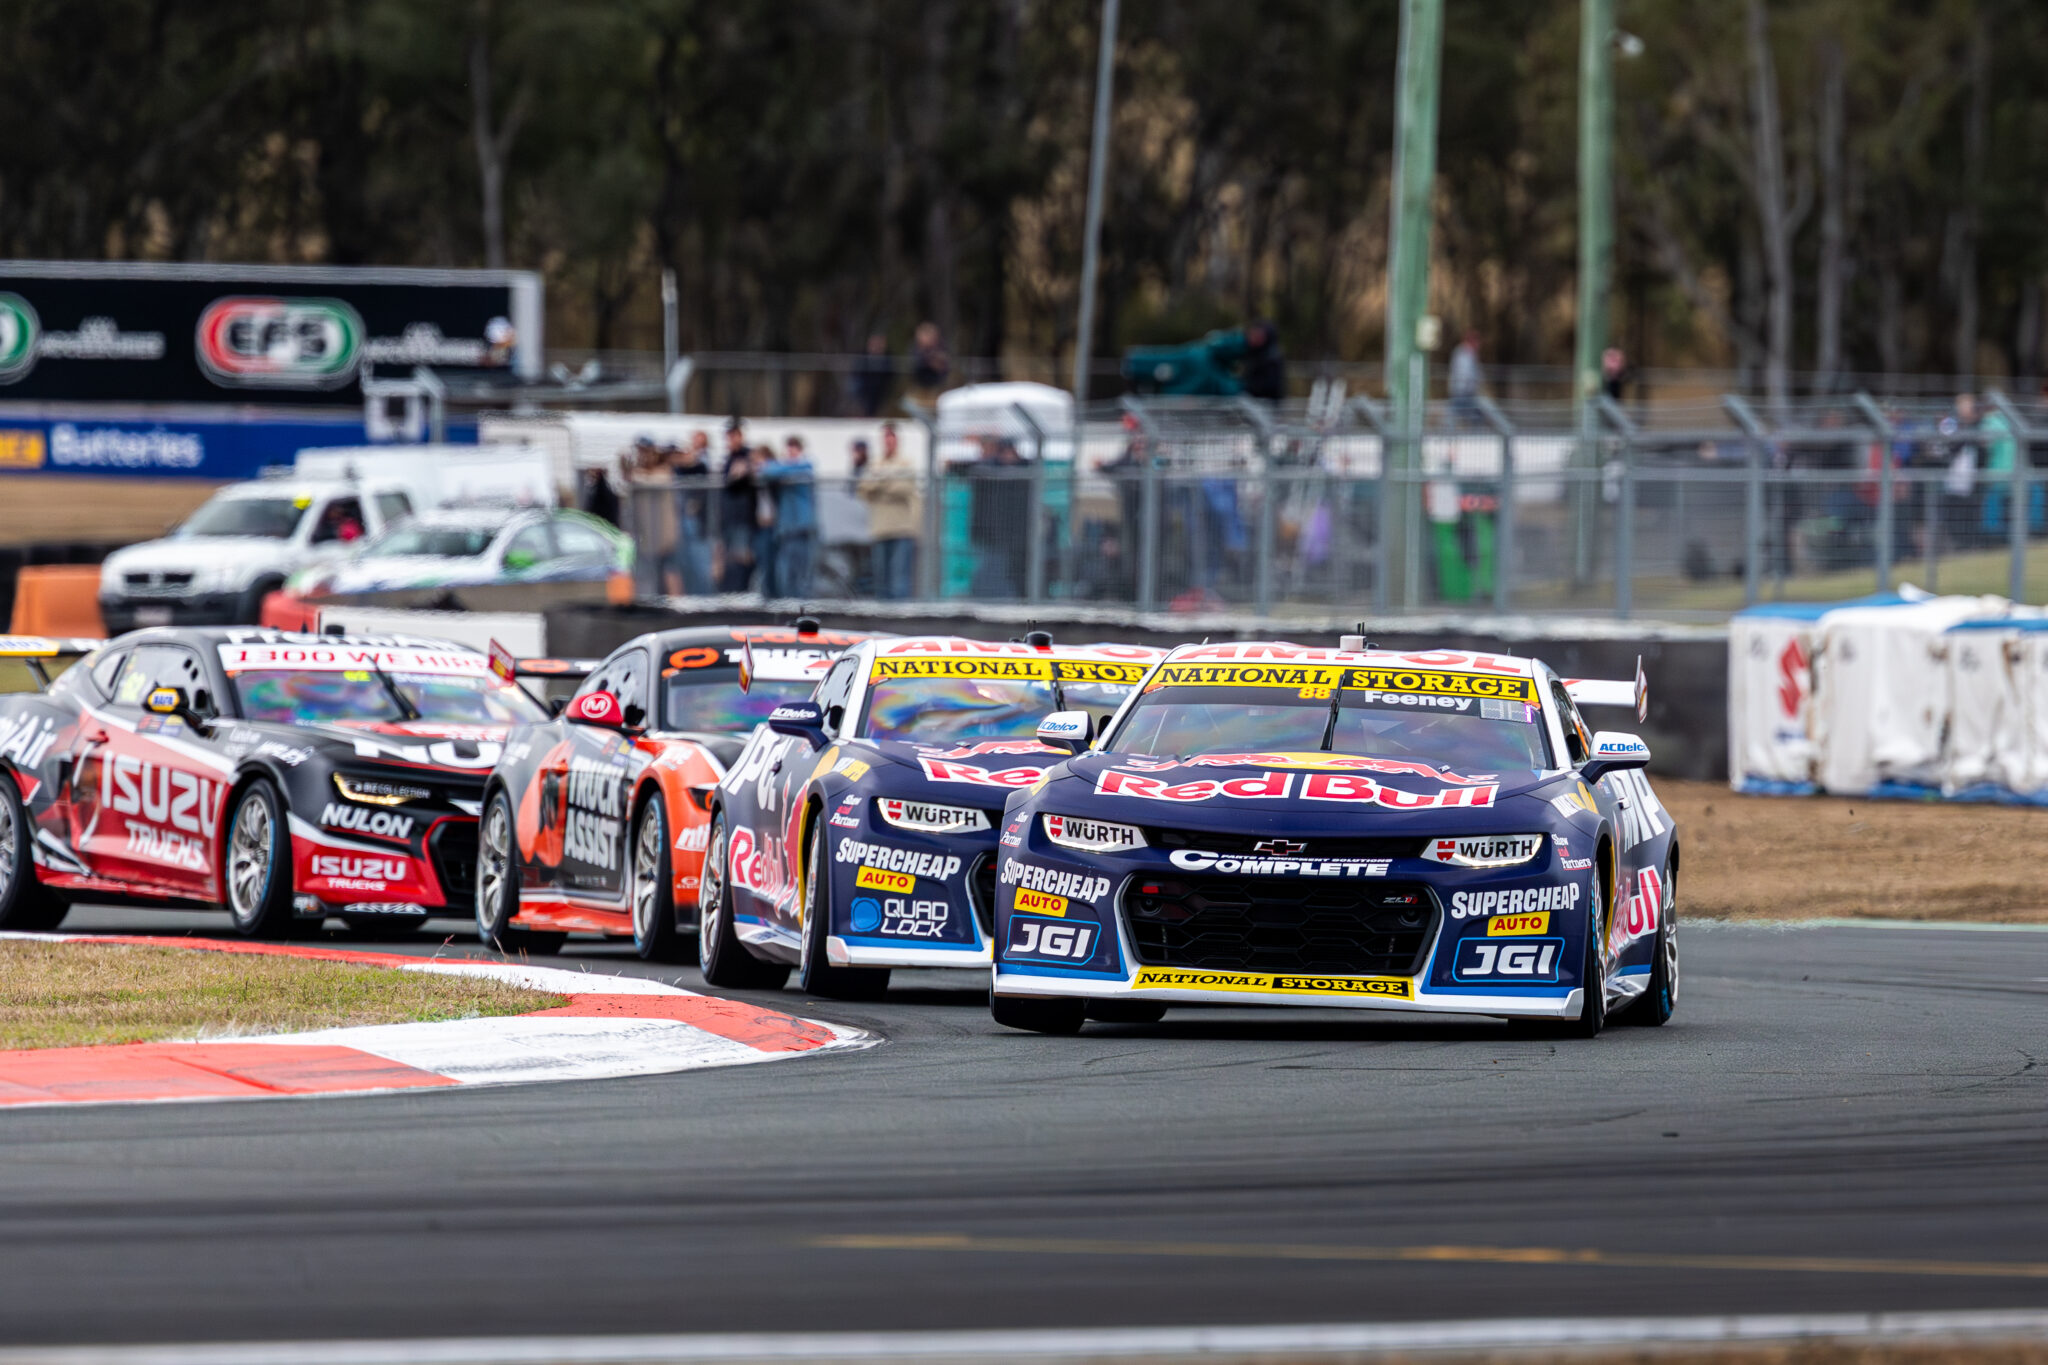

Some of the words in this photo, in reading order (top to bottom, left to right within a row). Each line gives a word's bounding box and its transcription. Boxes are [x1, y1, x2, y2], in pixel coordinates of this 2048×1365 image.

[52, 423, 205, 468] Batteries
[235, 650, 336, 664] 1300
[879, 660, 1042, 676] NATIONAL
[1058, 663, 1146, 681] STOR
[1159, 668, 1332, 685] NATIONAL
[1353, 671, 1521, 697] STORAGE
[1298, 687, 1331, 699] 88
[1365, 690, 1472, 710] Feeney
[103, 750, 224, 839] ISUZU
[567, 754, 625, 818] TRUCK
[1094, 770, 1295, 802] Red
[1300, 773, 1499, 809] Bull
[320, 802, 414, 839] NULON
[906, 805, 977, 827] WÜRTH
[125, 818, 204, 870] TRUCKS
[564, 807, 619, 871] ASSIST
[1066, 821, 1134, 845] WÜRTH
[836, 837, 961, 881] SUPERCHEAP
[1460, 840, 1533, 858] WÜRTH
[312, 855, 406, 881] ISUZU
[1560, 856, 1592, 869] Partners
[327, 877, 387, 891] TRUCKS
[863, 872, 909, 888] AUTO
[1001, 857, 1111, 904] SUPERCHEAP
[884, 898, 948, 921] QUAD
[1020, 893, 1062, 911] AUTO
[1451, 882, 1580, 919] SUPERCHEAP
[881, 918, 947, 938] LOCK
[1494, 917, 1542, 930] AUTO
[1010, 923, 1092, 958] JGI
[1462, 945, 1555, 975] JGI
[1139, 973, 1268, 987] NATIONAL
[1282, 978, 1402, 994] STORAGE
